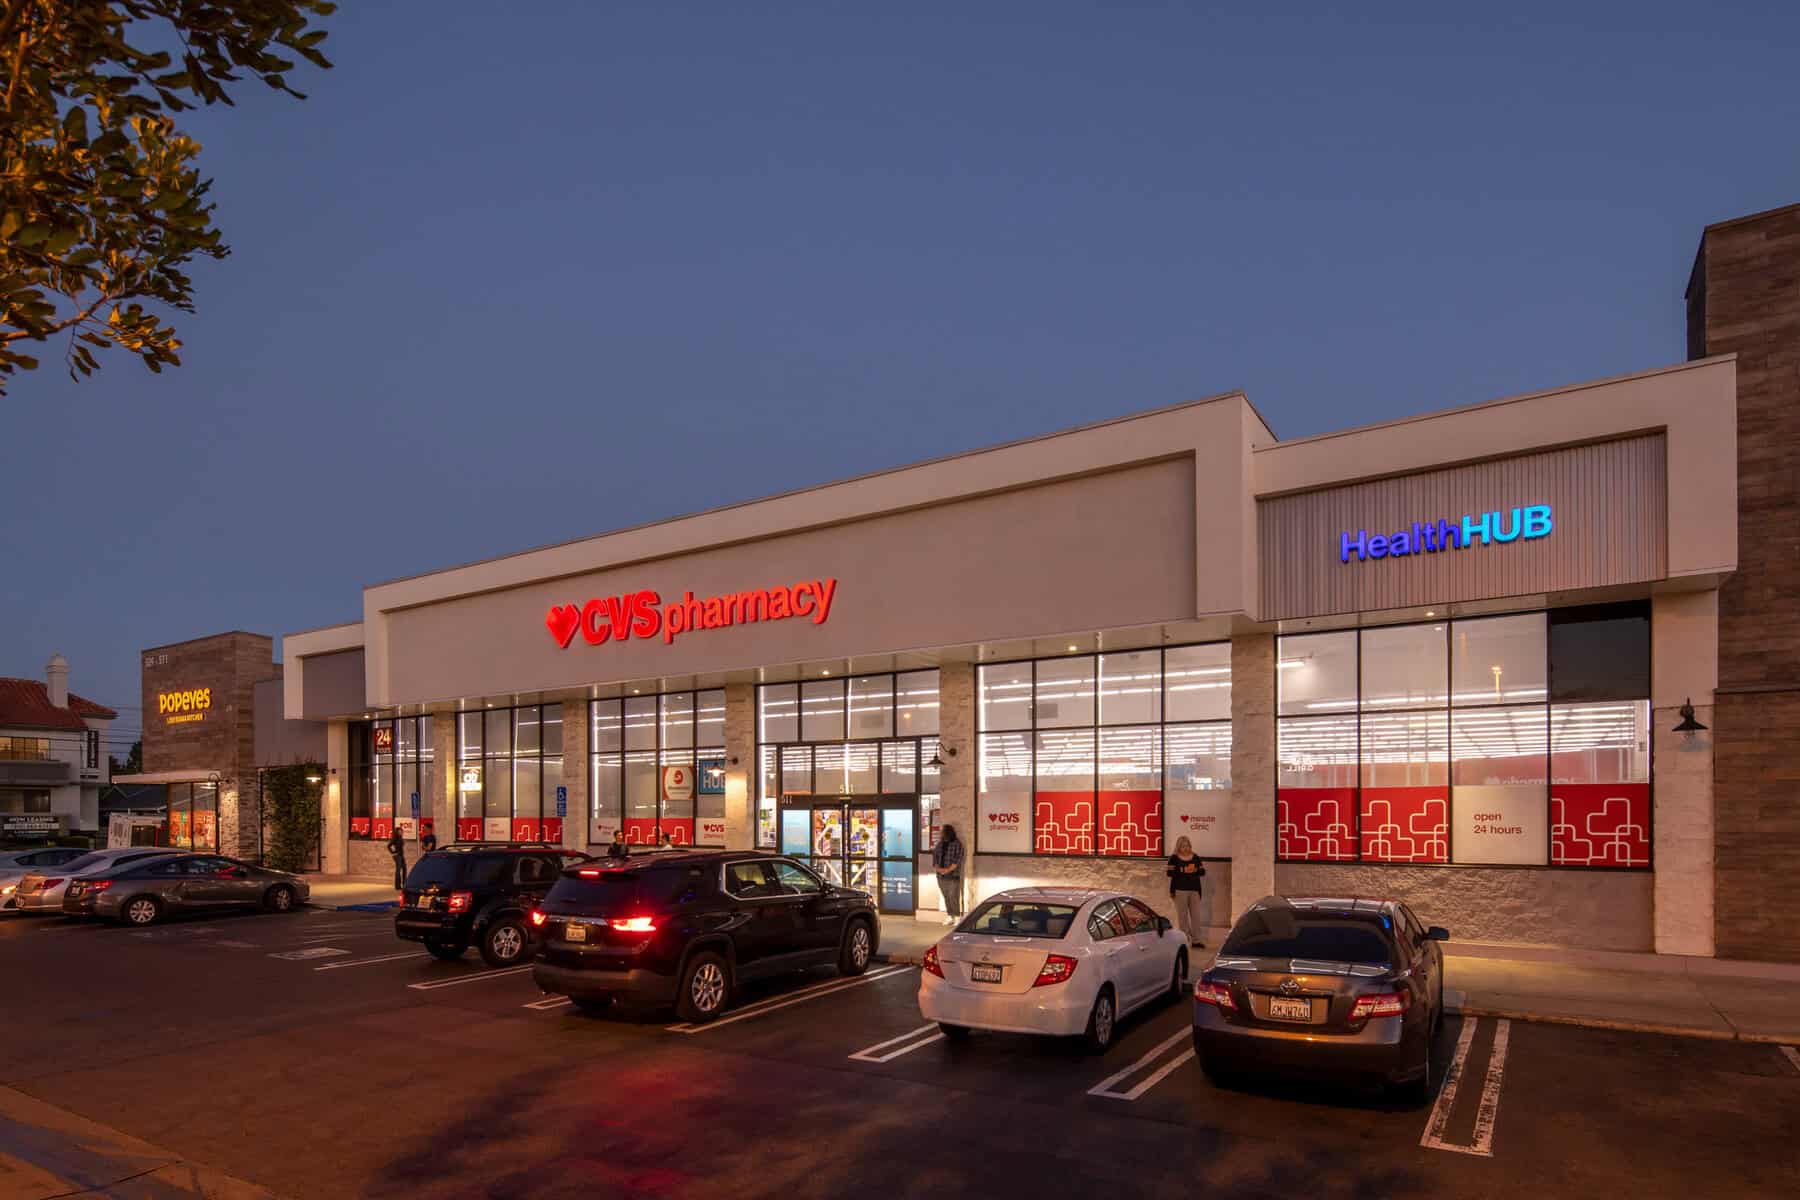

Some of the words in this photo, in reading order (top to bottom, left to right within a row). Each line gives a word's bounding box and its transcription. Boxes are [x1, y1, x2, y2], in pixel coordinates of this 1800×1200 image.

[1340, 504, 1553, 563] HealthHUB
[580, 589, 662, 646] CVS
[664, 577, 837, 644] pharmacy
[376, 729, 392, 746] 24
[998, 812, 1020, 823] CVS
[1473, 812, 1502, 823] open
[1473, 825, 1487, 834] 24
[1490, 824, 1522, 834] hours
